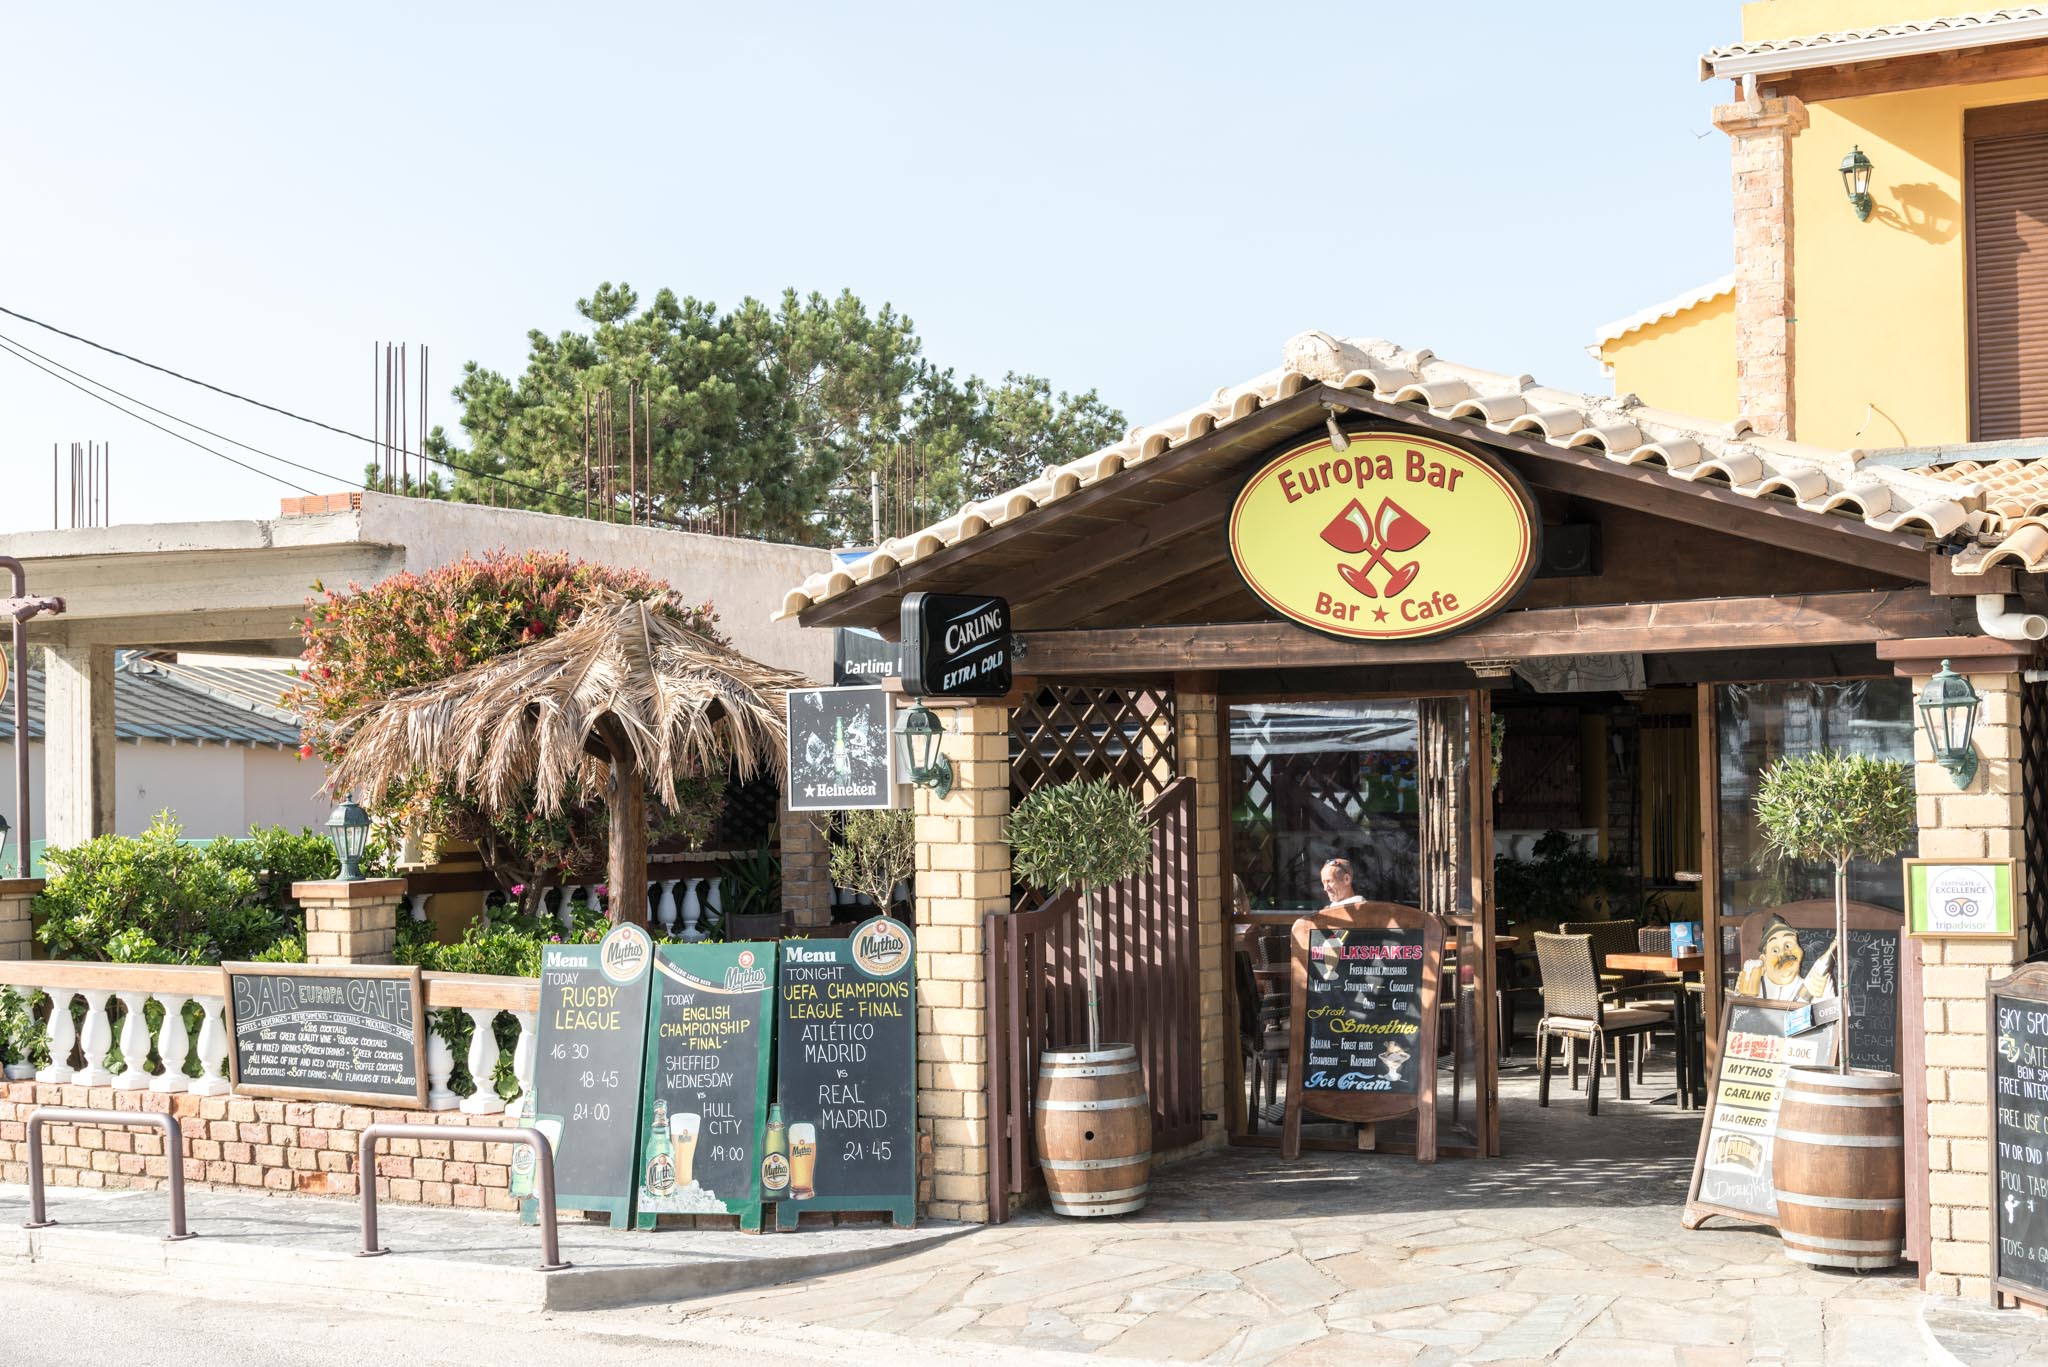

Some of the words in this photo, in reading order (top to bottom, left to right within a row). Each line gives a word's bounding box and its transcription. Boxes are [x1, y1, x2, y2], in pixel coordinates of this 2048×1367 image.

[1277, 454, 1393, 504] Europa
[1405, 449, 1464, 493] Bar
[1314, 591, 1360, 622] Bar
[1400, 590, 1461, 623] Cafe
[944, 608, 1003, 655] CARLING
[845, 658, 893, 677] Carling
[943, 664, 977, 691] EXTRA
[981, 650, 1004, 675] COLD
[816, 780, 877, 798] Heineken
[1935, 886, 1988, 894] EXCELLENCE
[607, 942, 643, 966] Mythos
[785, 946, 837, 963] Menu
[860, 935, 904, 960] Mythos
[1311, 945, 1423, 961] MLKSHAKES
[546, 951, 589, 968] Menu
[546, 972, 581, 986] TODAY
[723, 966, 767, 994] Mythos
[785, 966, 845, 981] TONIGHT
[560, 986, 619, 1008] RUGBY
[664, 993, 695, 1006] TODAY
[783, 984, 819, 1001] UEFA
[232, 975, 299, 1022] BAR
[299, 985, 345, 1006] EUROPA
[346, 979, 413, 1029] CAFE
[789, 1002, 844, 1019] LEAGUE
[858, 1001, 904, 1018] FINAL
[555, 1010, 622, 1031] LEAGUE
[682, 1005, 731, 1022] ENGLISH
[1307, 1005, 1346, 1020] Fresh
[1999, 1007, 2021, 1032] SKY
[319, 1024, 348, 1035] COCKTAILS
[659, 1019, 751, 1038] CHAMPIONSHIP
[801, 1021, 875, 1042] ATLÉTICO
[1329, 1018, 1419, 1035] Smoothies
[279, 1031, 297, 1041] GREEK
[297, 1032, 320, 1043] QUALITY
[360, 1037, 388, 1048] COCKTAILS
[262, 1043, 280, 1053] MIXED
[281, 1043, 301, 1054] DRINKS
[325, 1047, 345, 1057] DRINKS
[373, 1050, 404, 1061] COCKTAILS
[805, 1043, 867, 1064] MADRID
[1787, 1046, 1813, 1060] 3.00€
[280, 1056, 288, 1065] OF
[288, 1056, 299, 1066] HOT
[299, 1057, 311, 1067] AND
[326, 1060, 350, 1071] COFFEES
[375, 1063, 404, 1073] COCKTAILS
[665, 1055, 720, 1072] SHEFFIED
[1727, 1063, 1774, 1079] MYTHOS
[307, 1069, 328, 1080] DRINKS
[372, 1073, 379, 1084] OF
[380, 1074, 391, 1085] TEA
[666, 1073, 734, 1089] WEDNESDAY
[1304, 1070, 1336, 1088] Ice
[1337, 1071, 1393, 1091] Cream
[1998, 1075, 2021, 1096] FREE
[818, 1083, 865, 1105] REAL
[1724, 1087, 1772, 1102] CARLING
[703, 1102, 735, 1118] HULL
[821, 1108, 888, 1130] MADRID
[709, 1119, 743, 1136] CITY
[1719, 1113, 1768, 1128] MAGNERS
[1998, 1107, 2022, 1128] FREE
[2023, 1112, 2042, 1134] USE
[710, 1145, 744, 1162] 19:00
[842, 1141, 893, 1161] 21:45
[1998, 1141, 2010, 1159] TV
[2012, 1144, 2024, 1162] OR
[2025, 1146, 2043, 1165] DVD
[763, 1164, 788, 1181] Mythos
[2000, 1169, 2025, 1194] POOL
[2026, 1174, 2048, 1198] TAB
[1999, 1236, 2025, 1258] TOYS
